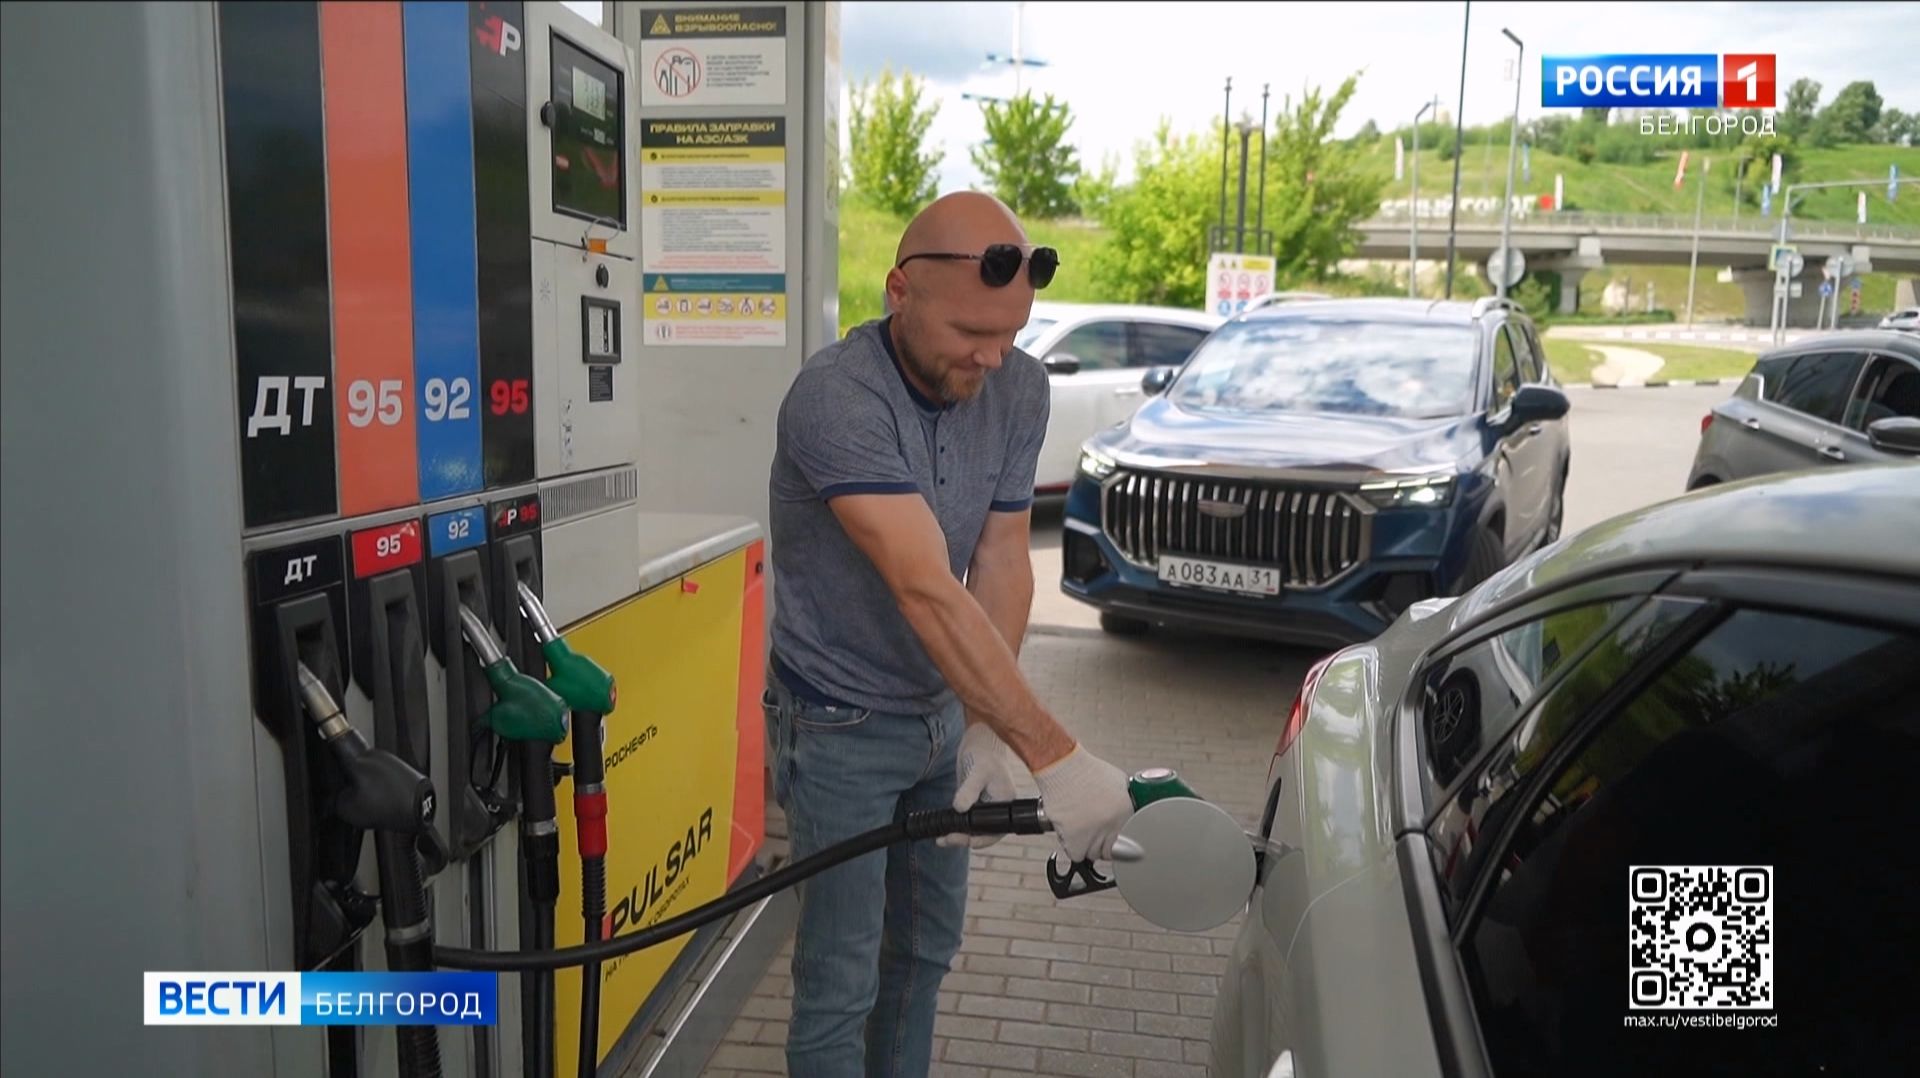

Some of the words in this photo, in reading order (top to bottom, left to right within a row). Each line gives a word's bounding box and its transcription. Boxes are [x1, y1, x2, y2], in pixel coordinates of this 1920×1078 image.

[675, 13, 740, 22] ВНИМАНИЕ
[675, 22, 777, 32] ВЗРЫВООПАСНО!
[650, 123, 708, 133] ПРАВИЛА
[709, 122, 776, 132] ЗАПРАВКИ
[676, 135, 694, 144] НА
[695, 134, 749, 144] АЗС/АЗК
[247, 376, 325, 437] ДТ
[347, 380, 403, 428] 95
[424, 377, 471, 421] 92
[490, 380, 528, 415] 95
[521, 504, 537, 521] 95
[448, 519, 470, 540] 92
[376, 534, 401, 558] 95
[284, 555, 317, 585] ДТ
[604, 724, 658, 774] РОСНЕФТЬ
[610, 806, 713, 937] PULSAR
